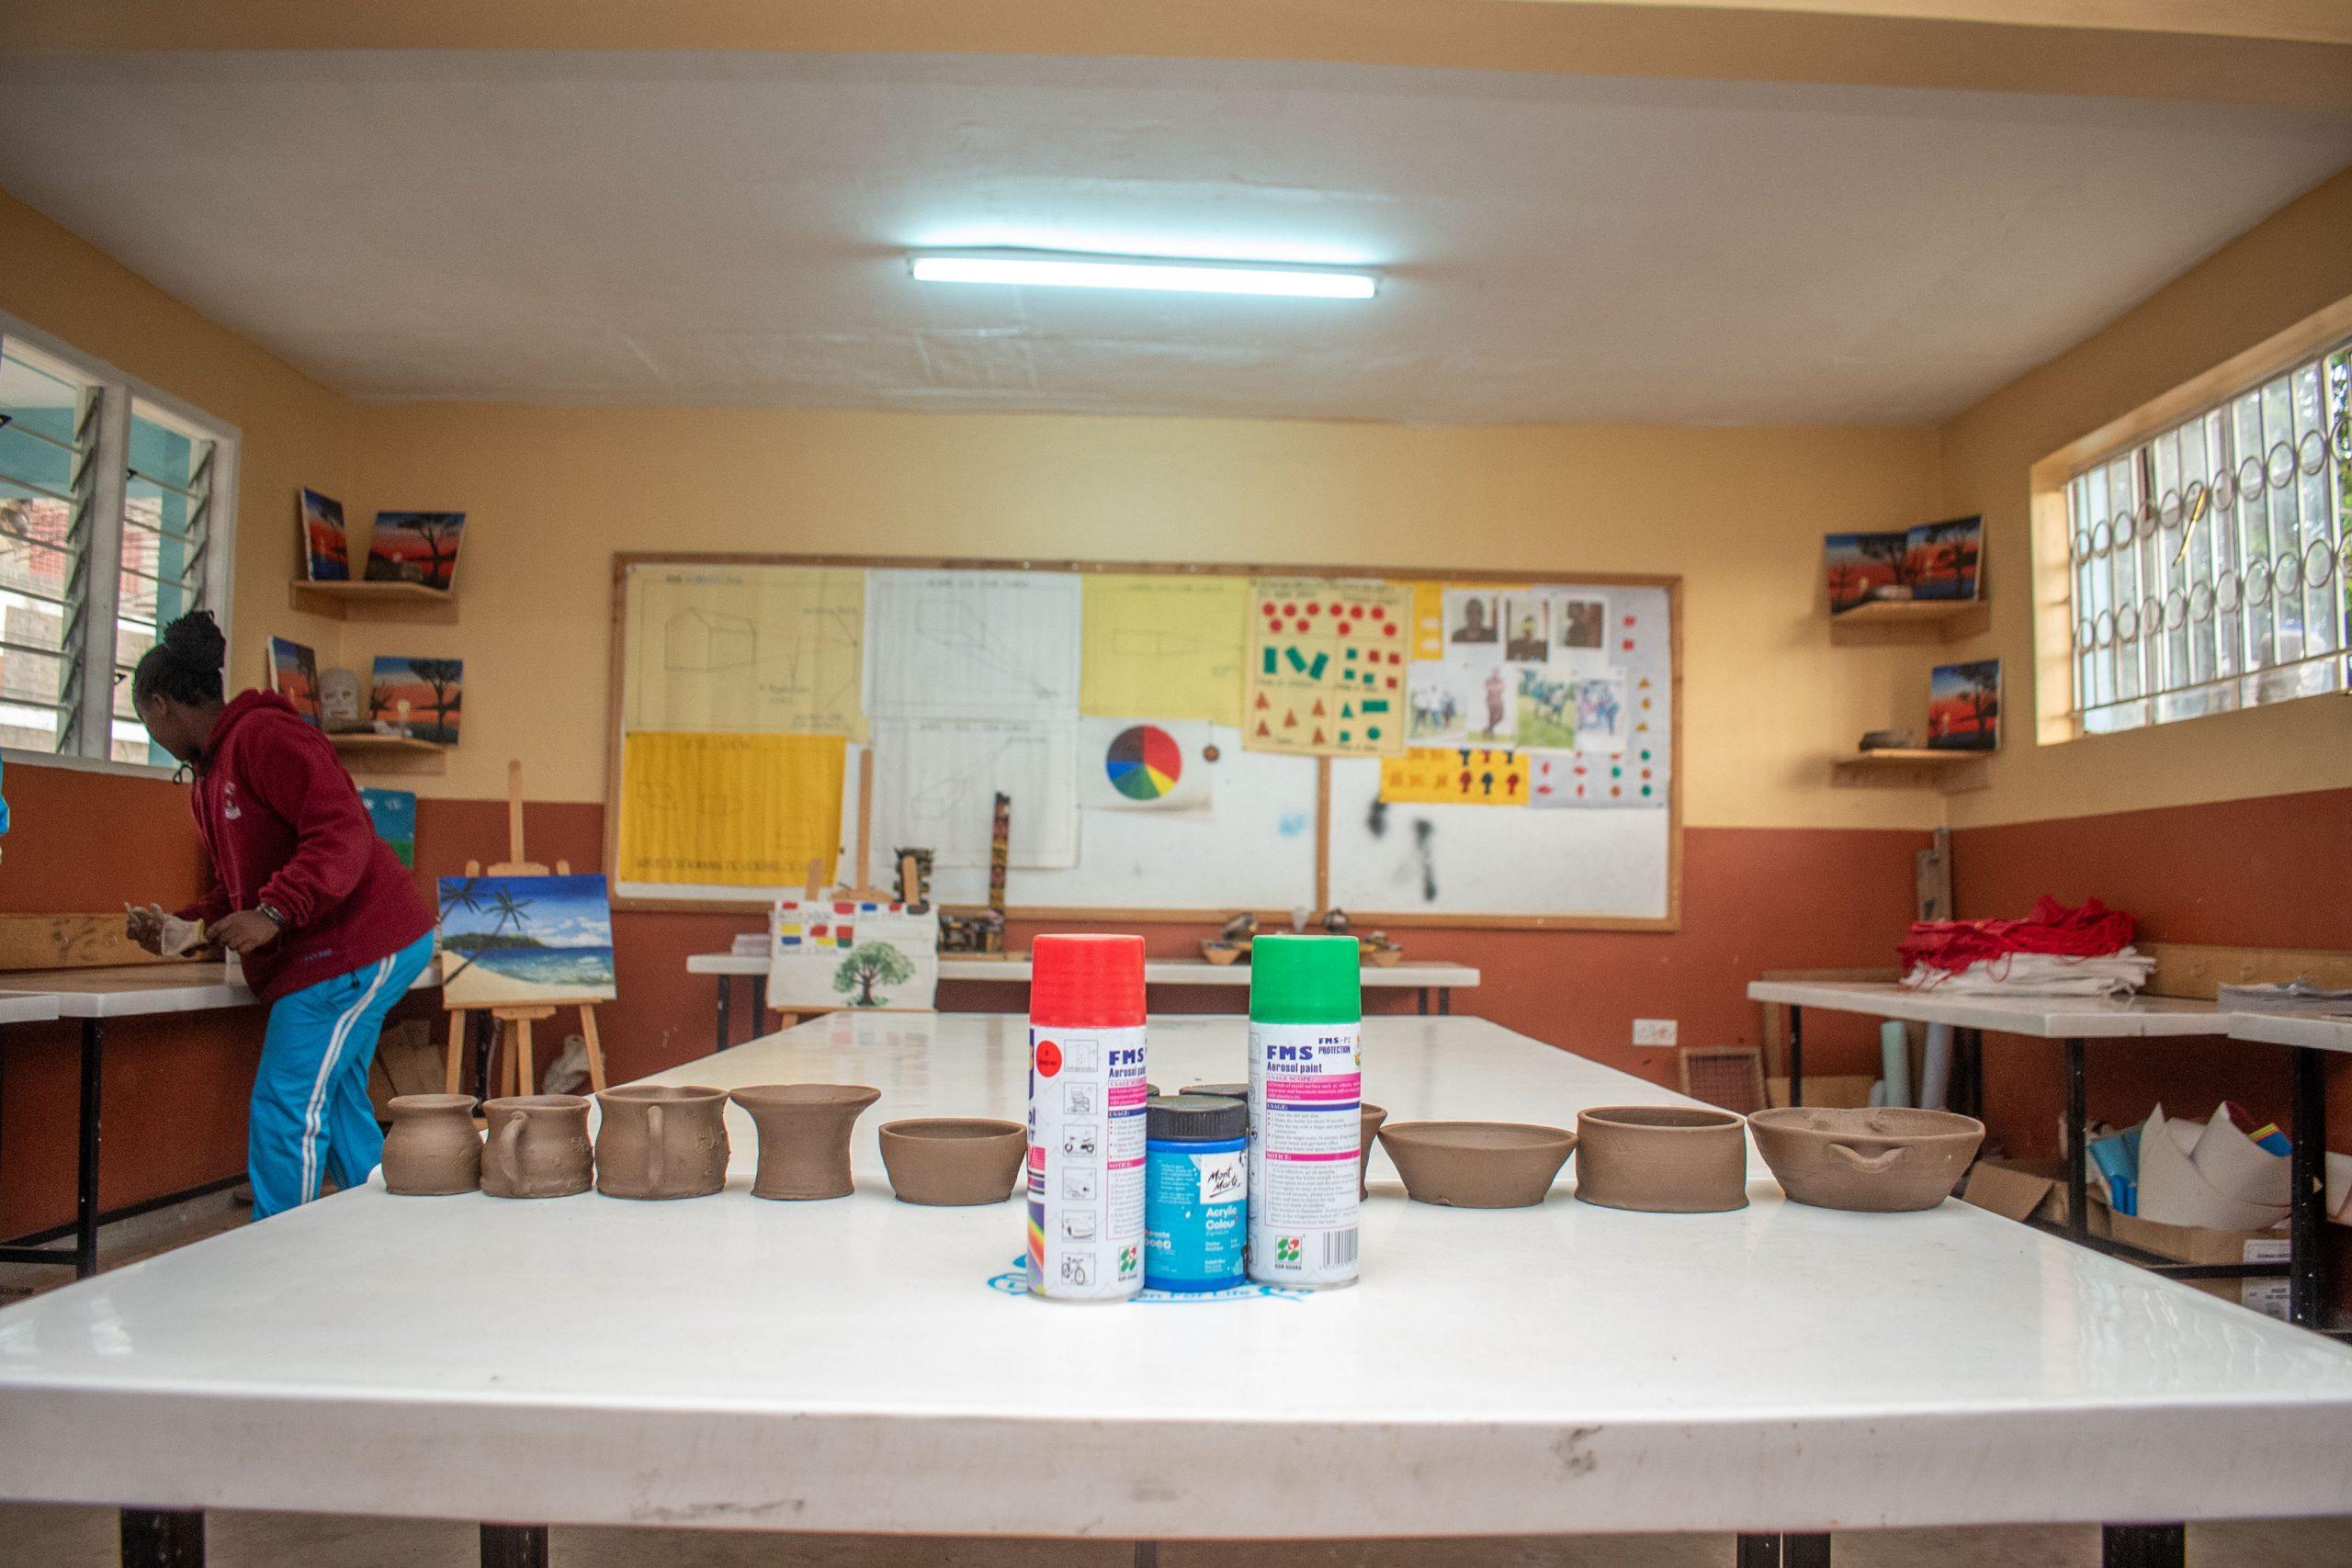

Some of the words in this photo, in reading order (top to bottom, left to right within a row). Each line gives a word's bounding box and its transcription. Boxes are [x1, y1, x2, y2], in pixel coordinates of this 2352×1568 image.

[1109, 1047, 1144, 1066] FMS
[1267, 1045, 1313, 1060] FMS
[1318, 1045, 1351, 1055] PROTECTION
[1109, 1067, 1137, 1077] Aerosol
[1267, 1062, 1298, 1073] Aerosol
[1300, 1063, 1322, 1074] paint
[1207, 1164, 1232, 1183] Mont
[1213, 1175, 1238, 1192] Marte
[1205, 1205, 1238, 1218] Acrylic
[1205, 1219, 1236, 1231] Colour
